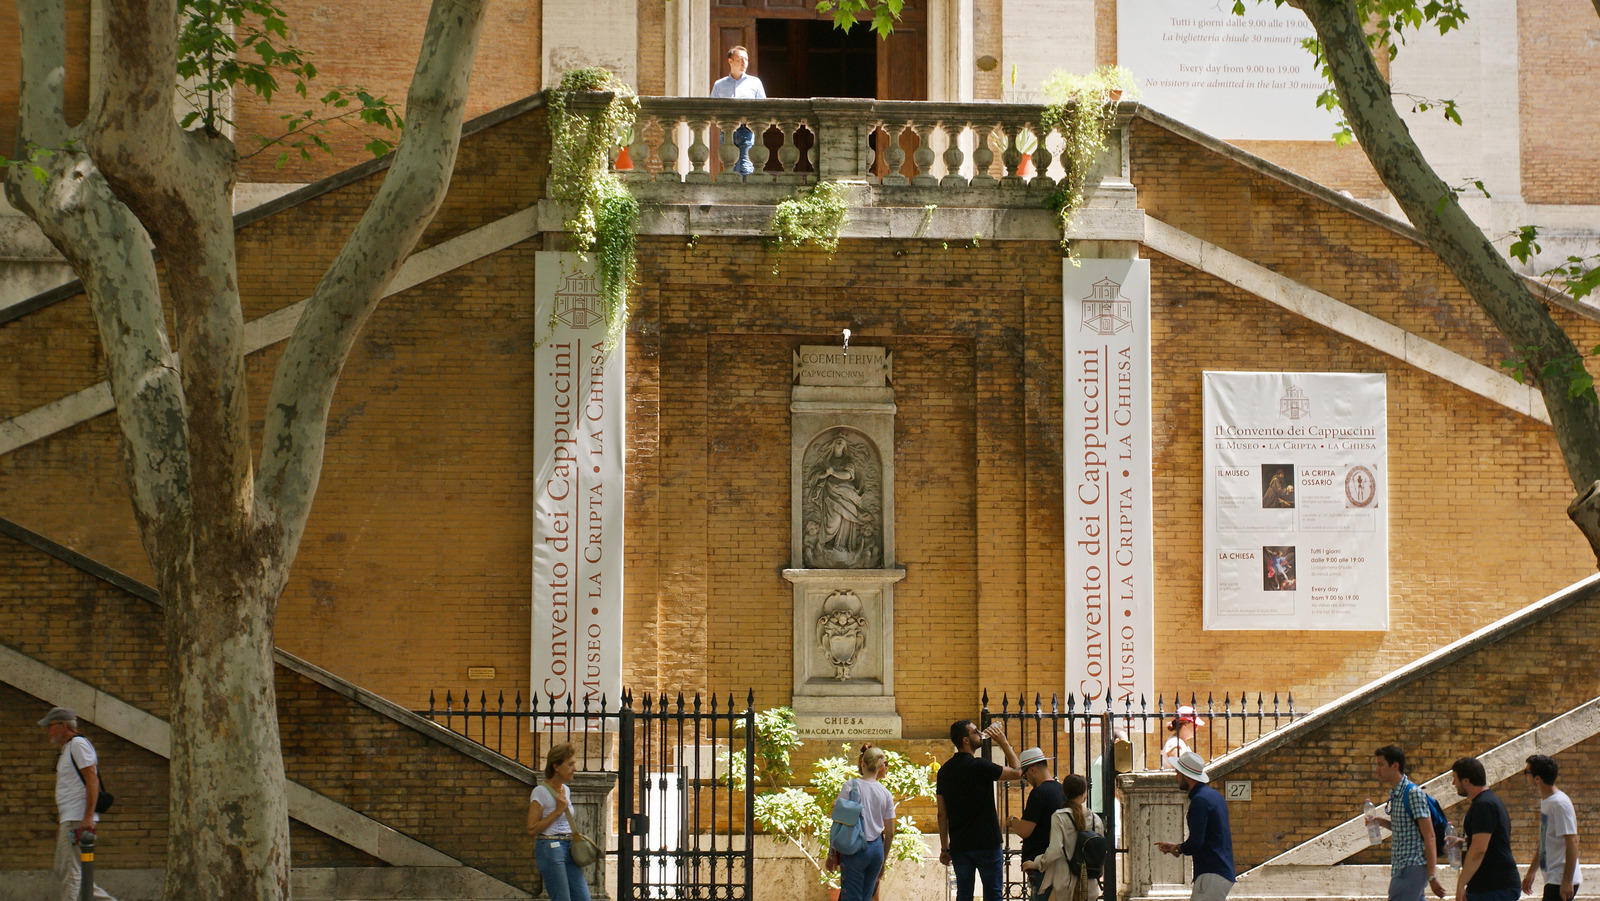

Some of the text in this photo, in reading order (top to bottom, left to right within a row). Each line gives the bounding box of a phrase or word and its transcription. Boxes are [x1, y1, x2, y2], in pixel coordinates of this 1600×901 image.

[1169, 17, 1309, 29] Tutti i giorni dalle 9.00 alle 19.00
[1162, 33, 1173, 41] La
[1175, 33, 1220, 44] biglietteria
[1222, 34, 1250, 42] chiude
[1252, 34, 1262, 42] 30
[1264, 35, 1292, 43] minuti
[1179, 64, 1204, 74] Every
[1205, 64, 1221, 75] day
[1223, 64, 1244, 72] from
[1246, 65, 1264, 73] 9.00
[1278, 66, 1301, 74] 19.00
[1145, 78, 1158, 87] No
[1160, 79, 1190, 87] visitors
[1206, 79, 1245, 88] admitted
[1246, 80, 1255, 88] in
[1257, 80, 1270, 88] the
[1271, 80, 1286, 89] last
[1288, 81, 1299, 89] 30
[801, 353, 883, 365] COEMETERIVM
[801, 370, 865, 379] CAPVCCINORVM
[1113, 346, 1132, 427] CHIESA
[547, 342, 577, 501] Cappuccini
[1077, 348, 1107, 505] Cappuccini
[1215, 425, 1375, 439] Il Convento dei Cappuccini
[590, 429, 604, 456] LA
[1119, 434, 1132, 460] LA
[1217, 469, 1250, 477] IL MUSEO
[1301, 469, 1336, 477] LA CRIPTA
[545, 511, 569, 552] dei
[584, 482, 603, 564] CRIPTA
[1077, 515, 1101, 556] dei
[1115, 487, 1134, 566] CRIPTA
[1219, 552, 1255, 560] LA CHIESA
[588, 571, 602, 599] LA
[1120, 574, 1134, 601] LA
[544, 562, 569, 699] Convento
[1080, 565, 1103, 701] Convento
[824, 717, 864, 725] CHIESA
[1230, 784, 1246, 797] 27
